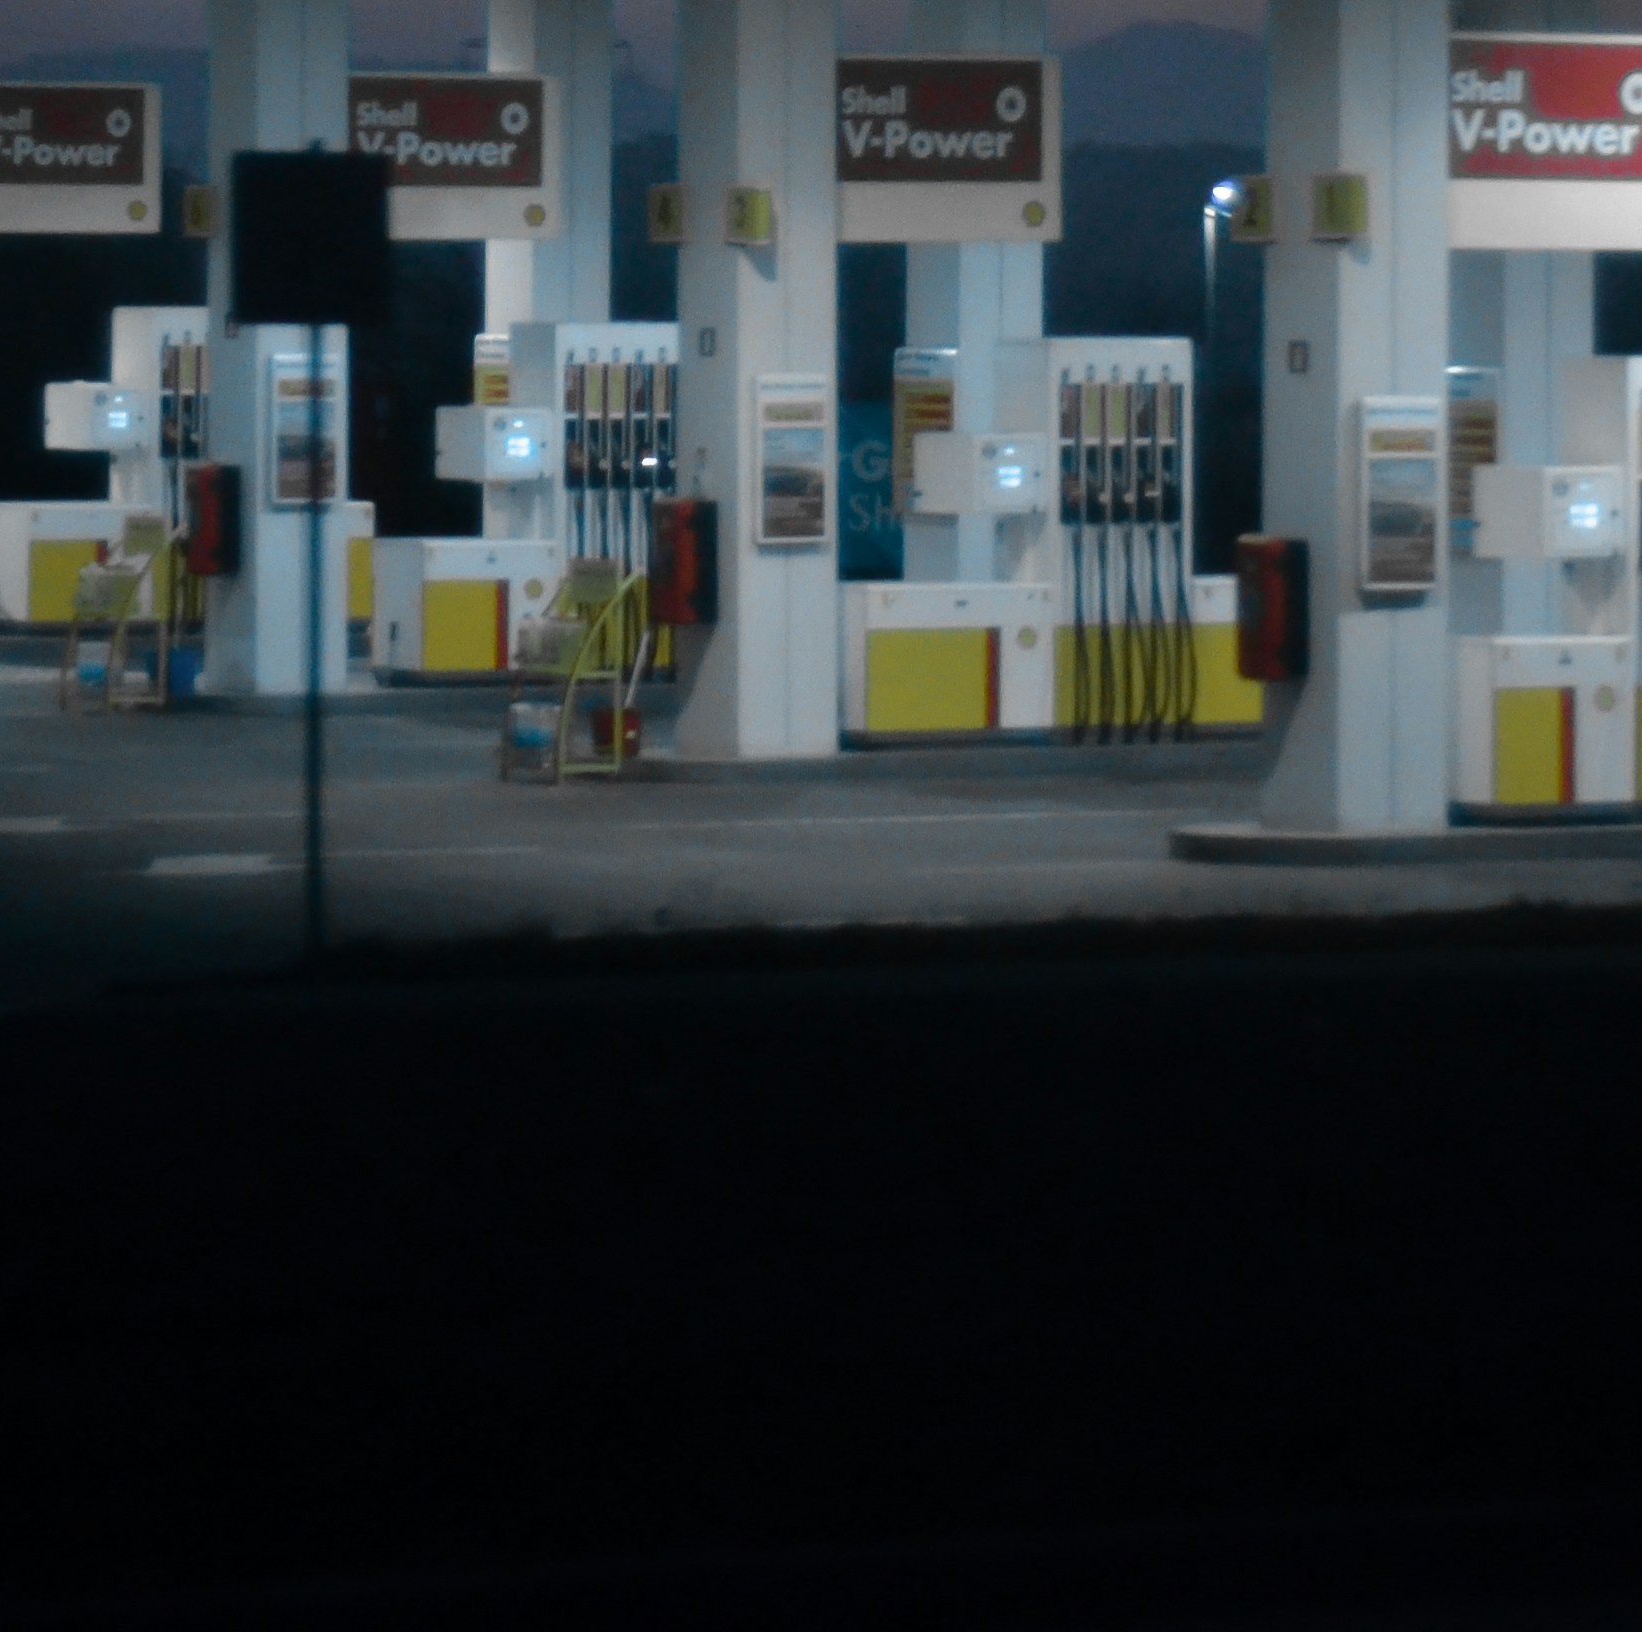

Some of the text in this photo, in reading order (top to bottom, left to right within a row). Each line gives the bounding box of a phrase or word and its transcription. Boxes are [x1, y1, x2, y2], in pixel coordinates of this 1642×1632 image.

[841, 85, 908, 116] Shell
[1450, 69, 1525, 104] Shell
[356, 99, 418, 127] Shell
[356, 130, 517, 167] V-Power
[841, 119, 1014, 160] V-Power
[1451, 108, 1642, 156] V-Power
